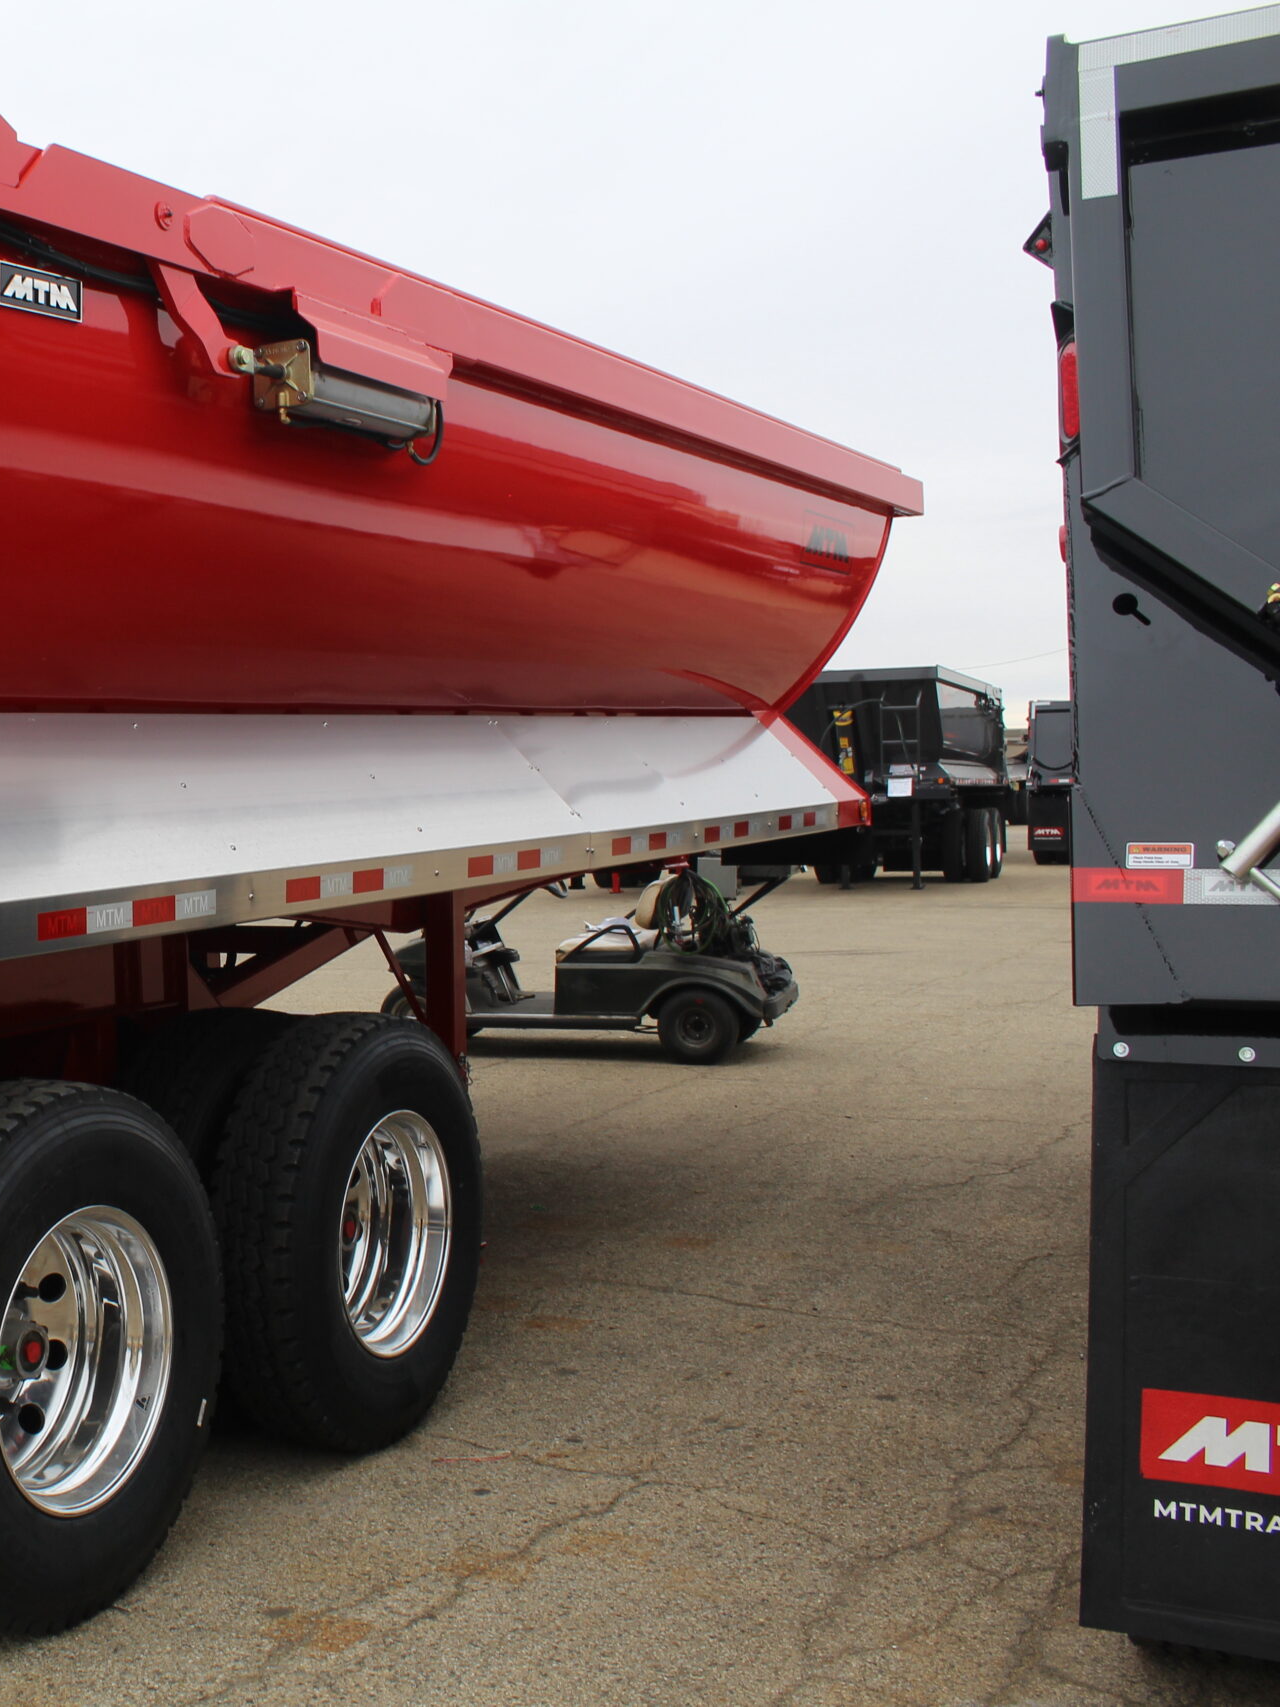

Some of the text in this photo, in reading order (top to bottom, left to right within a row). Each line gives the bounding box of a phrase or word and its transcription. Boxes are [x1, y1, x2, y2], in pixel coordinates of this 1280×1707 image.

[3, 273, 78, 313] MTM
[805, 524, 849, 563] MTM
[1034, 827, 1062, 836] MTM
[327, 876, 347, 894] MTM
[1096, 878, 1160, 892] MTM
[183, 895, 209, 915] MTM
[96, 908, 124, 928] MTM
